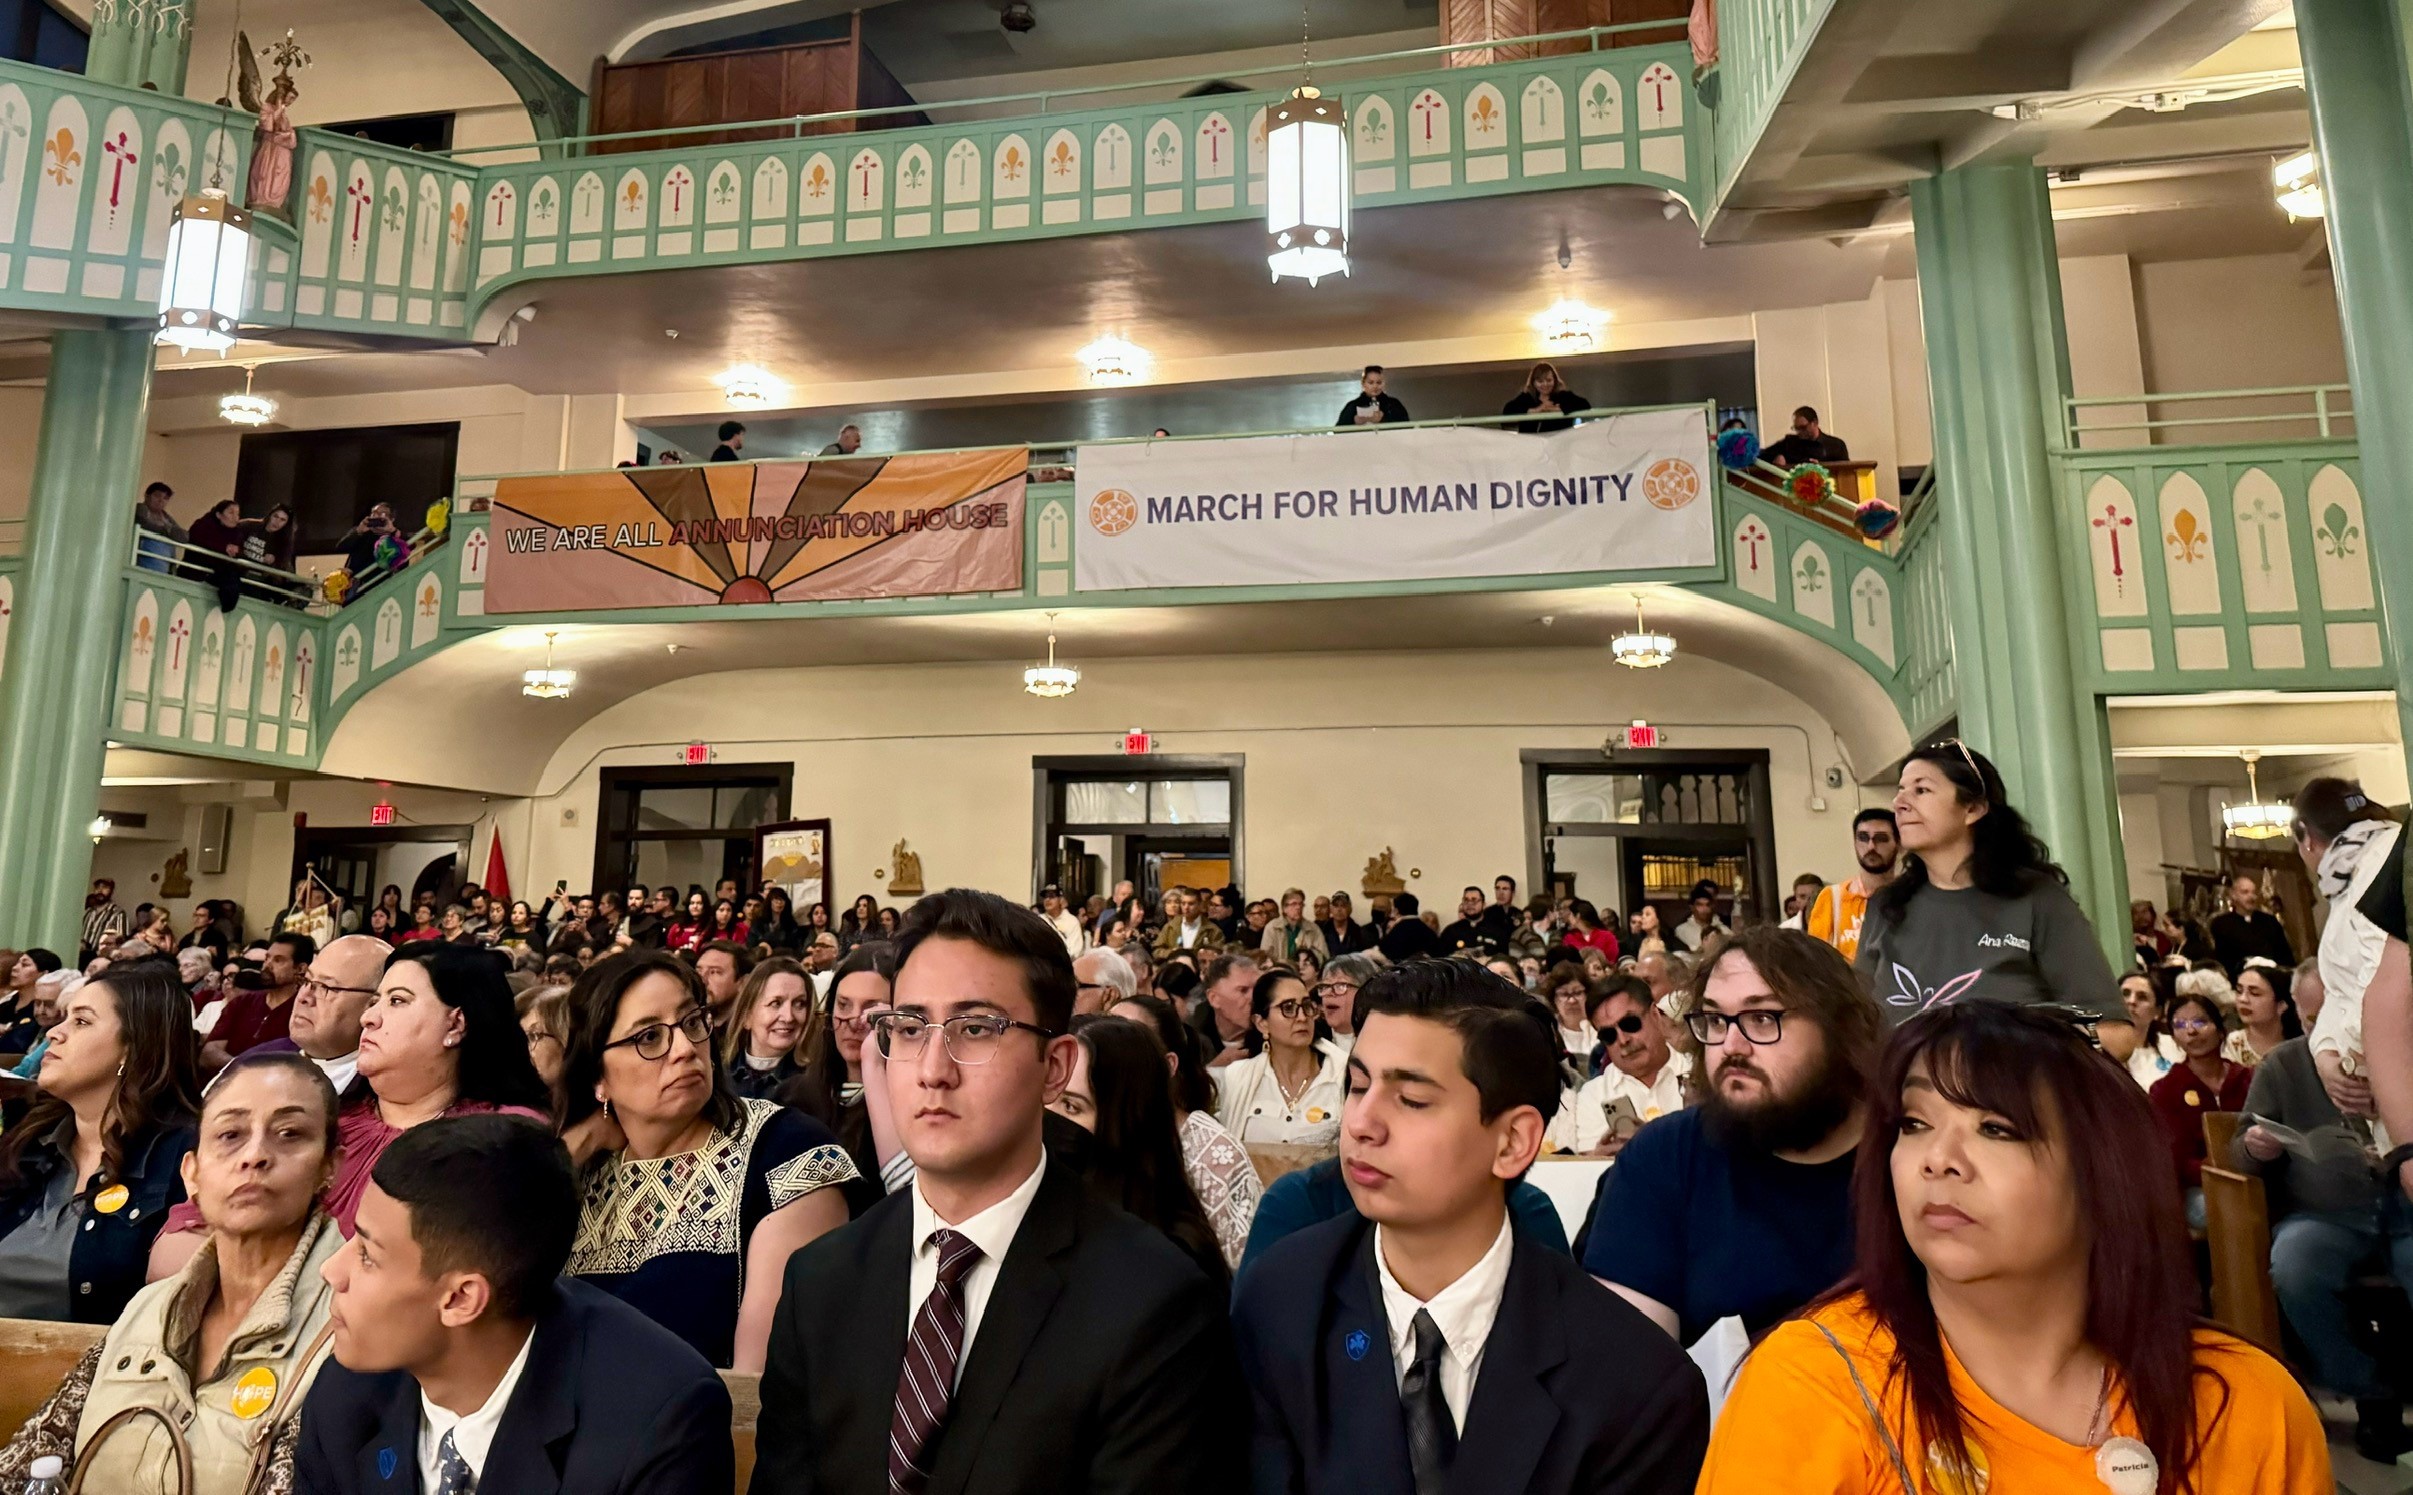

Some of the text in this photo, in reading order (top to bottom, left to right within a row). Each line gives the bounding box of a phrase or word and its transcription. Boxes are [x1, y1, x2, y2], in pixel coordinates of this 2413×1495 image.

[1146, 472, 1634, 525] MARCH FOR HUMAN DIGNITY
[506, 502, 1008, 554] WE ARE ALL ANNUNCIATION HOUSE
[1631, 727, 1656, 748] EXIT
[687, 746, 708, 764] EXIT
[373, 807, 393, 824] EXIT
[1978, 933, 2001, 947] Ana
[232, 1383, 273, 1403] HOPE
[2111, 1462, 2149, 1473] Patricia
